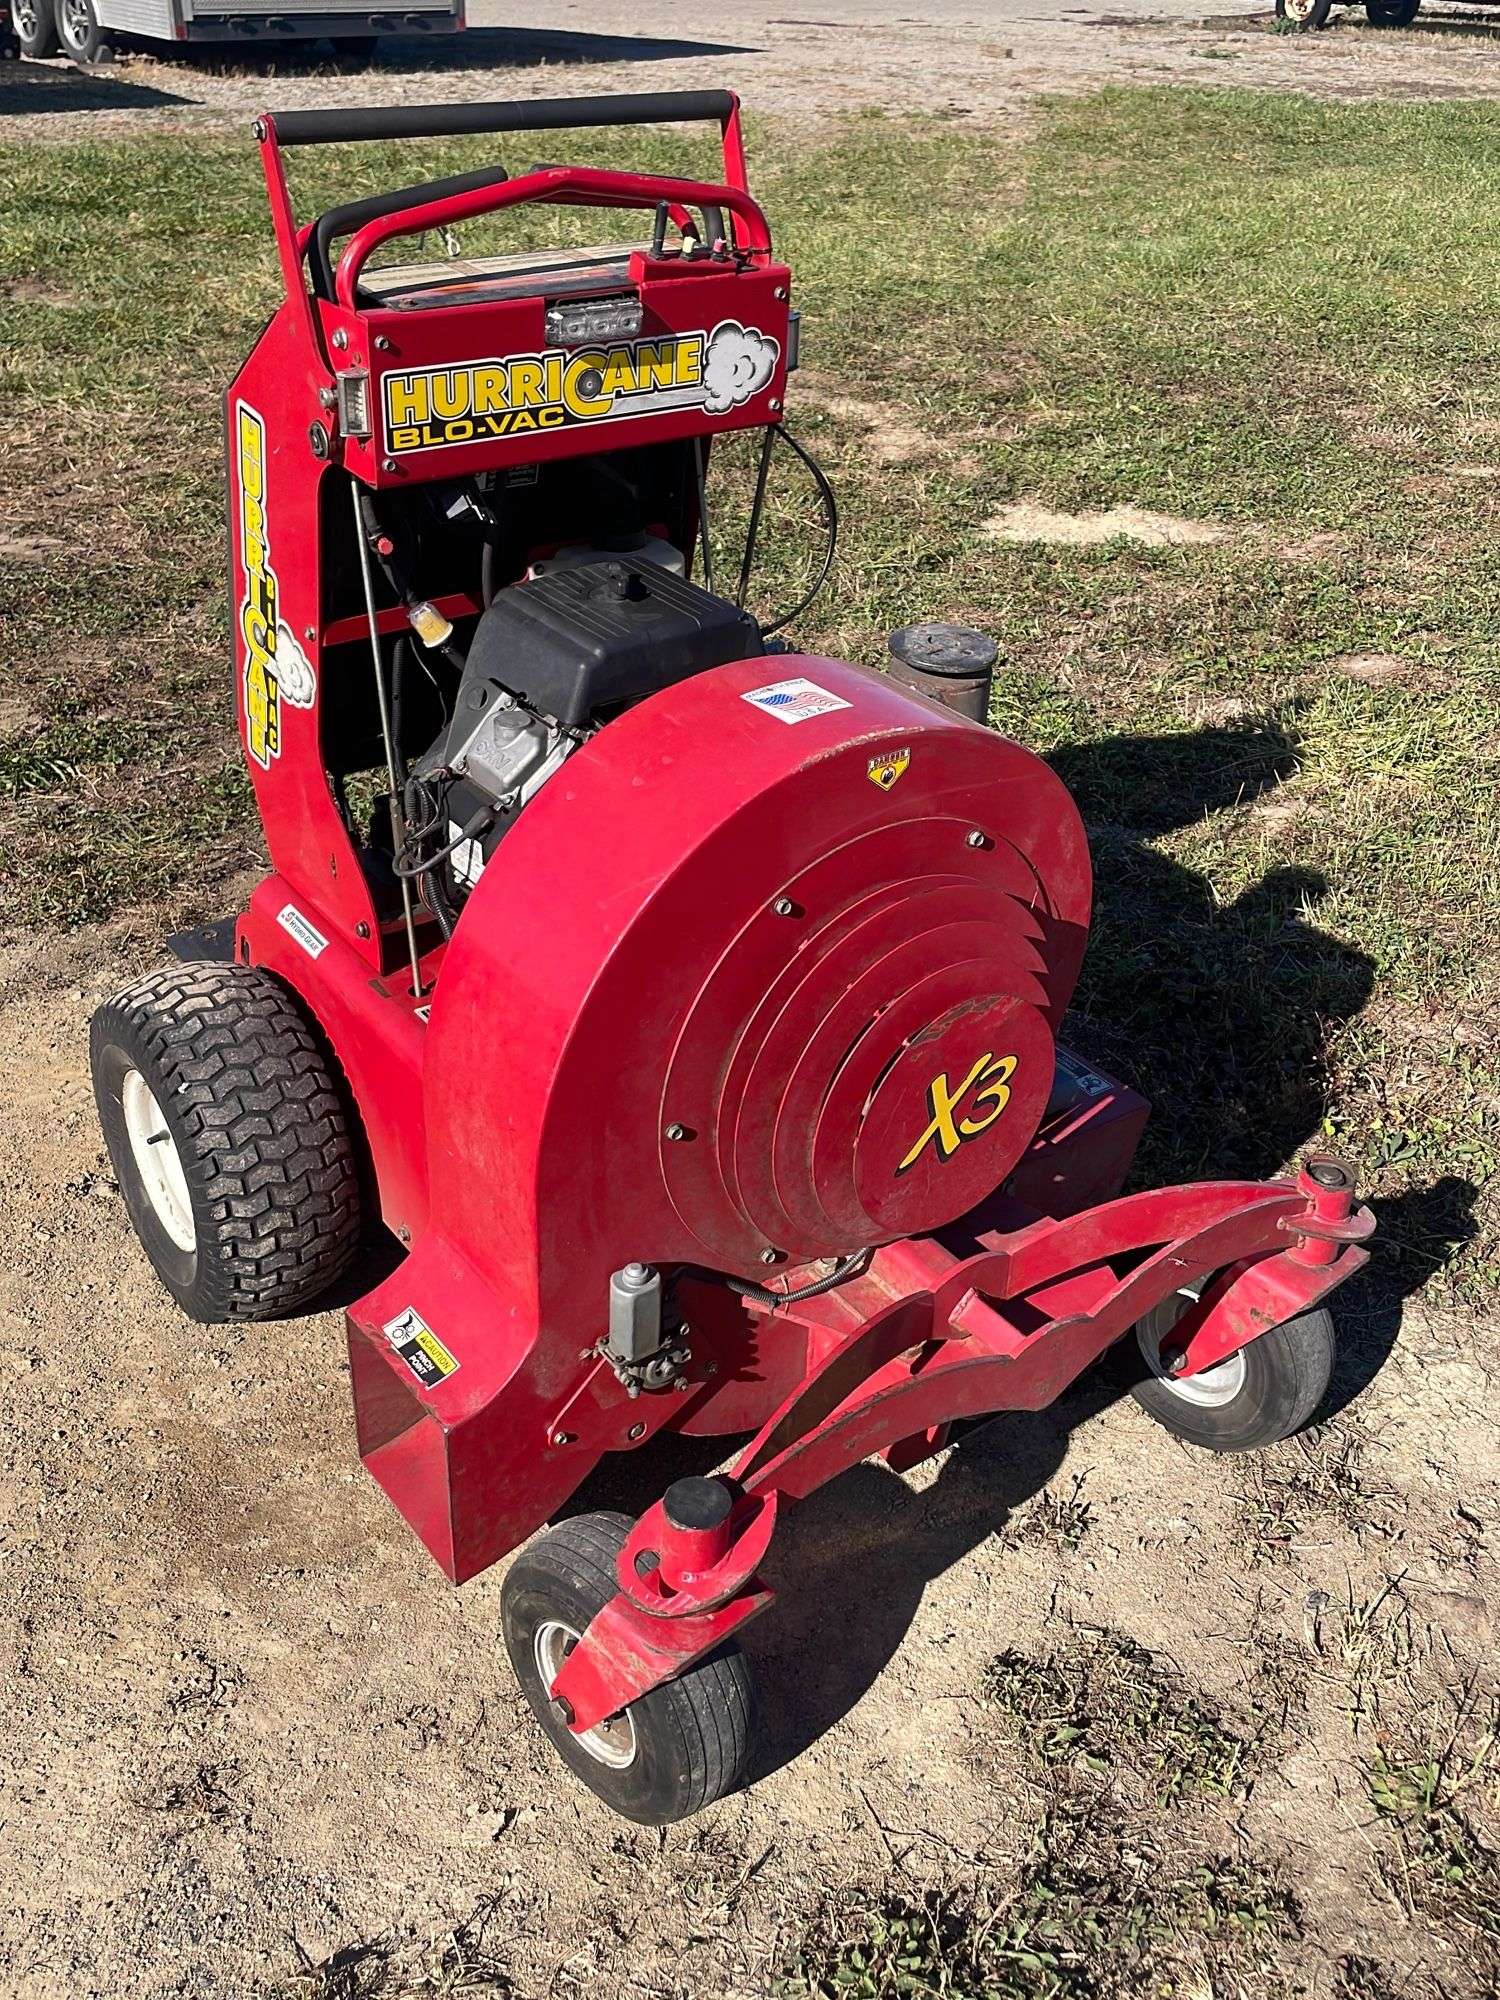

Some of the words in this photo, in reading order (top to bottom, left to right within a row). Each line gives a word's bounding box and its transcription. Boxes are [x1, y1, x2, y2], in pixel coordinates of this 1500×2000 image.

[391, 340, 702, 418] HURRICANE
[393, 405, 565, 450] BLO-VAC
[241, 413, 268, 762] HURRICANE
[896, 1052, 1018, 1177] X3
[408, 1354, 428, 1375] POINT
[415, 1349, 436, 1371] PINCH
[423, 1338, 452, 1370] CAUTION
